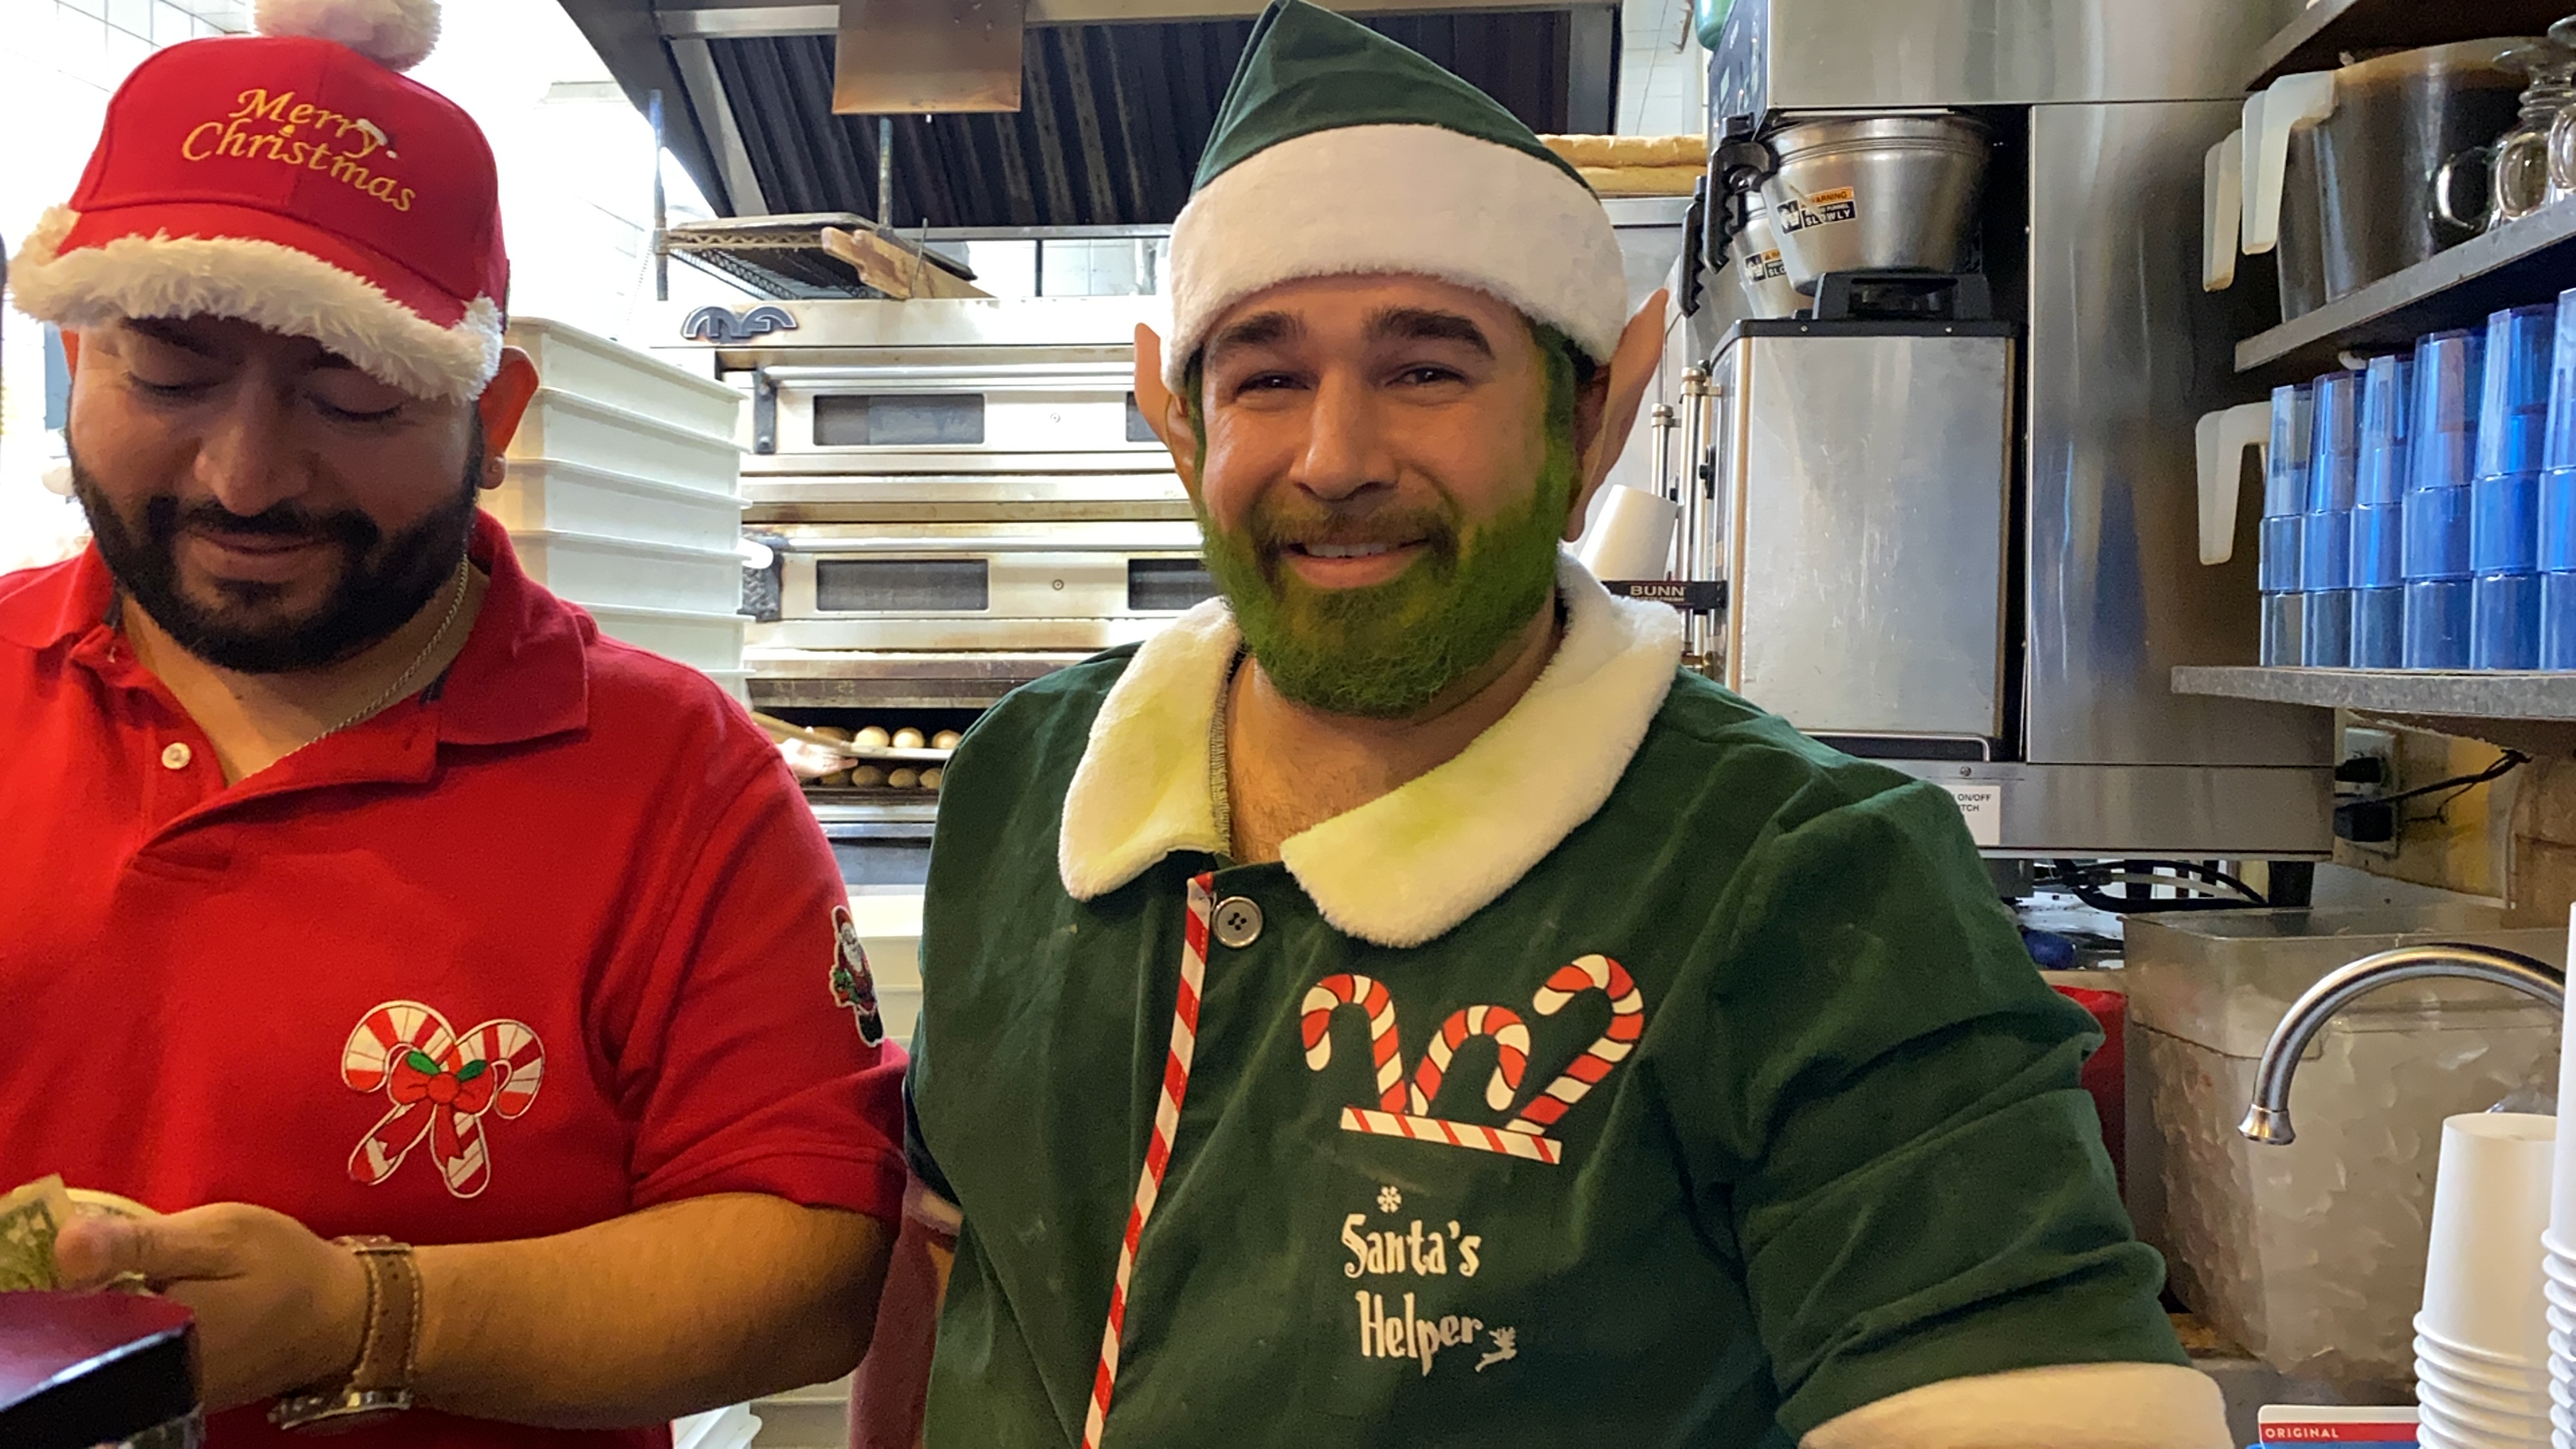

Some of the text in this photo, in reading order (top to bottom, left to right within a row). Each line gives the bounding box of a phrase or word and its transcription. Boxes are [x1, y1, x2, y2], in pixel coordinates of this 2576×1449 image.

[229, 89, 381, 158] Merry
[182, 118, 416, 211] Christmas
[1630, 585, 1684, 596] BUNN
[1957, 793, 1992, 802] ON/OFF
[1341, 1213, 1482, 1279] Santa's
[1355, 1290, 1484, 1377] Helper
[2265, 1428, 2339, 1439] ORIGINAL
